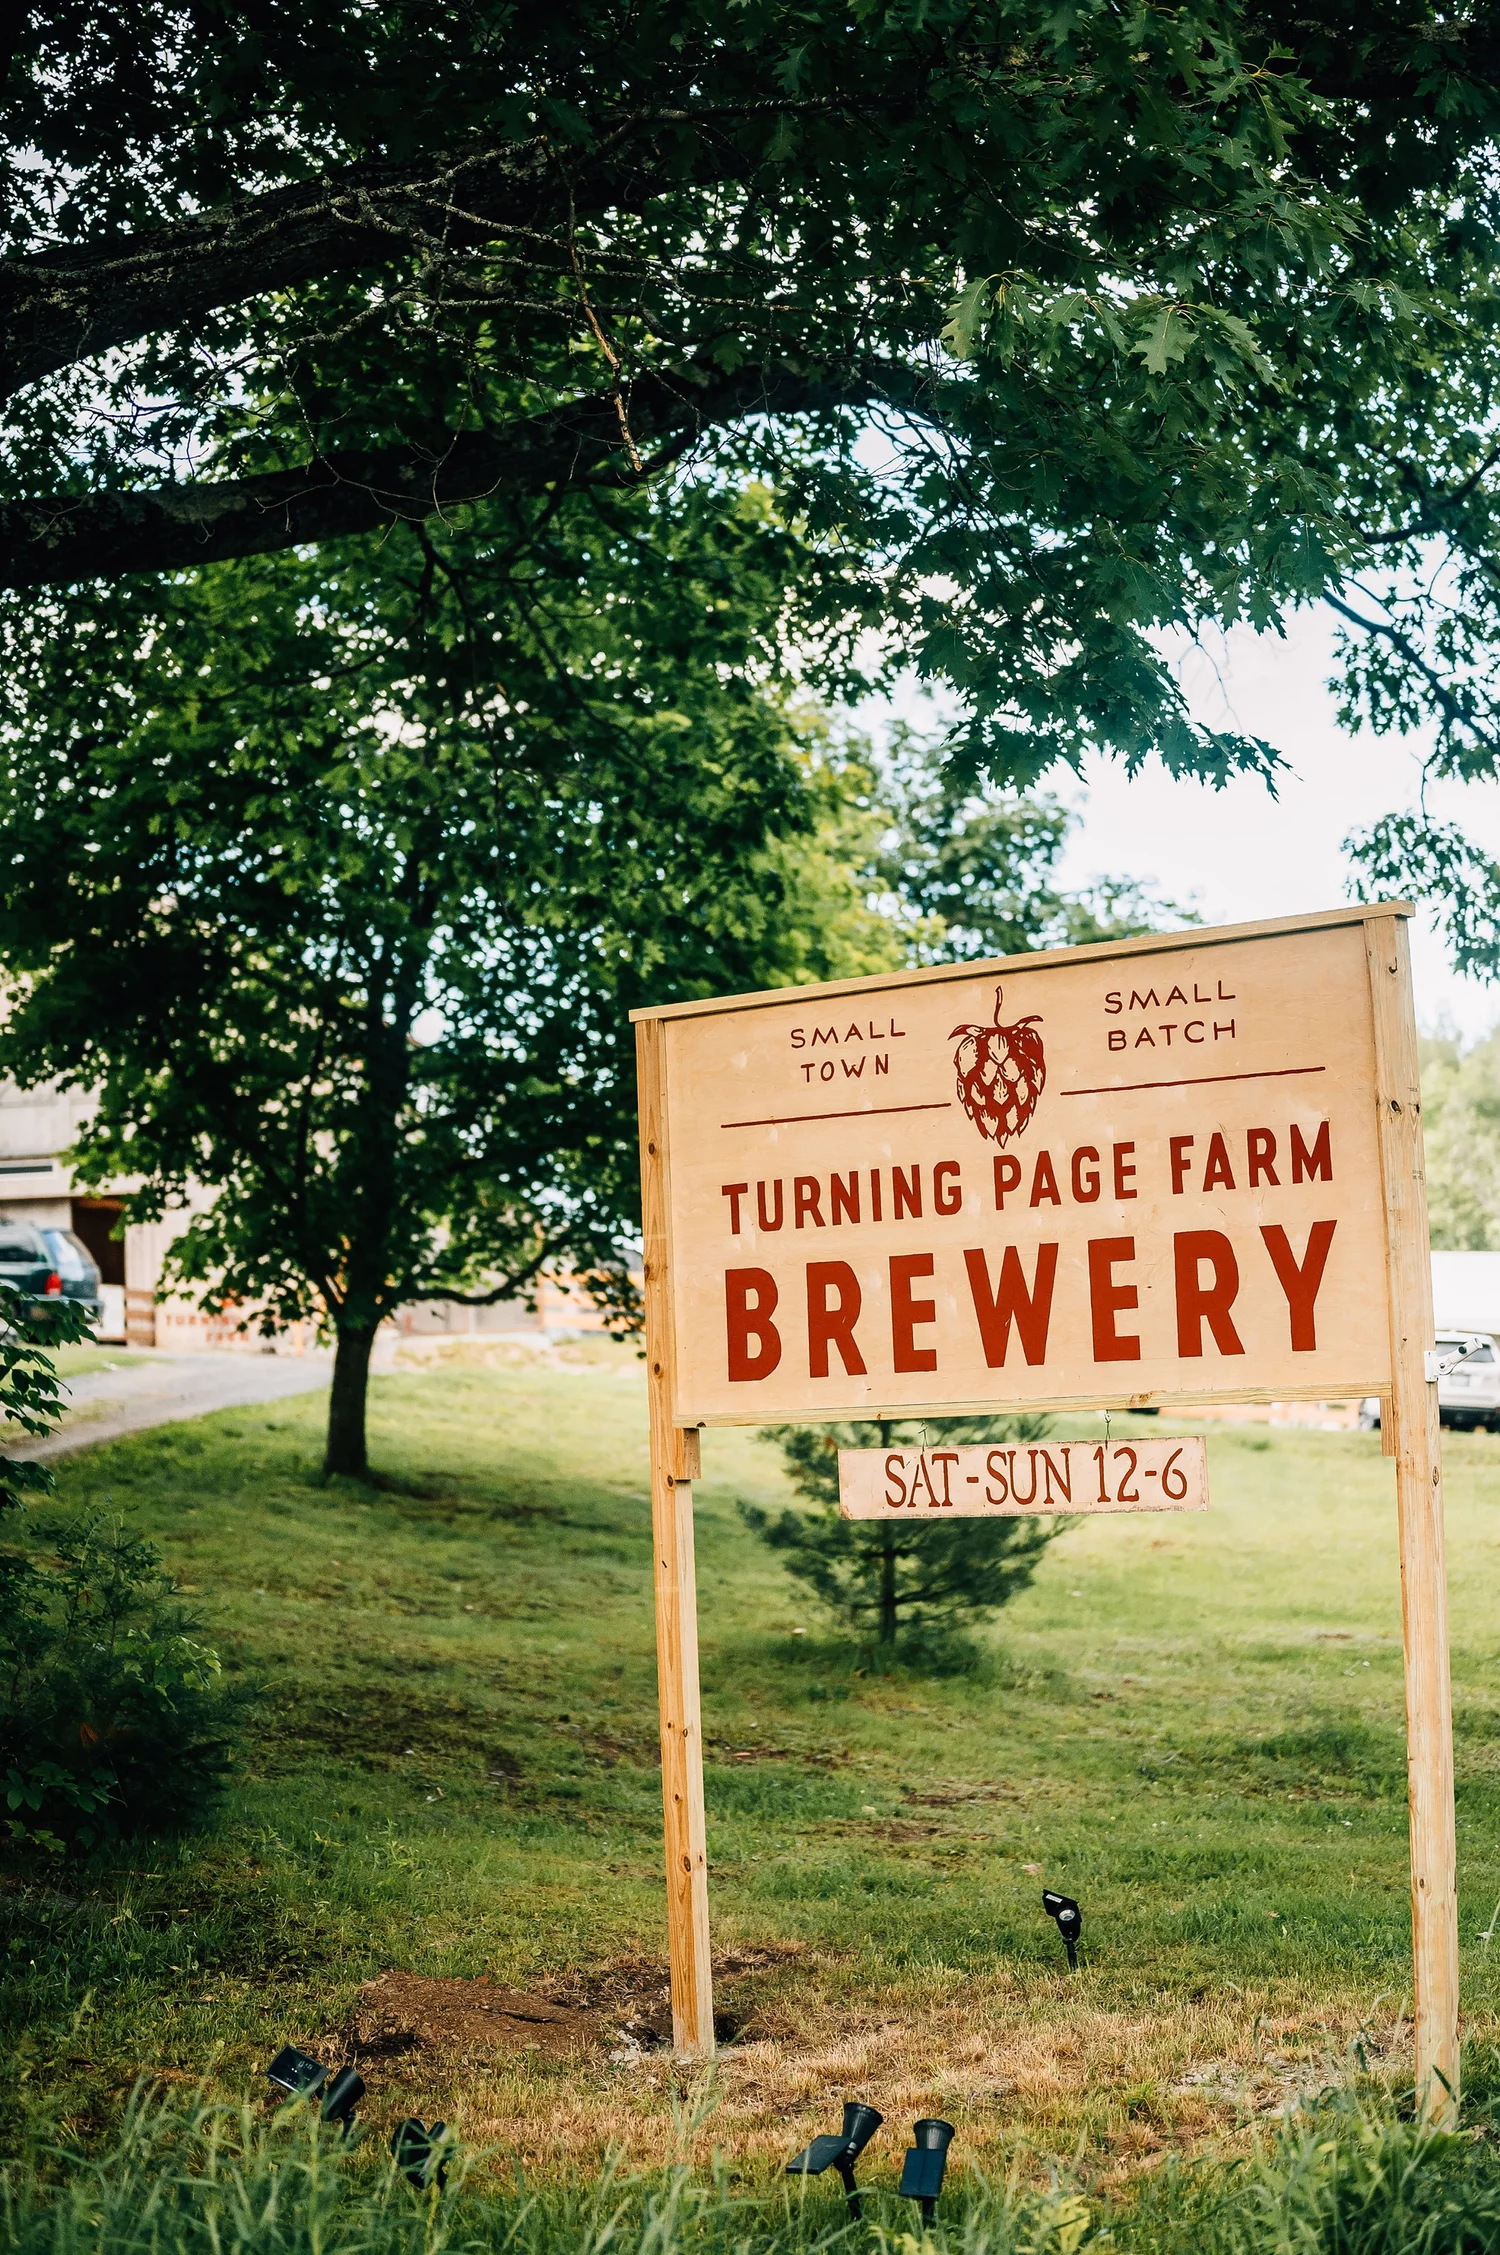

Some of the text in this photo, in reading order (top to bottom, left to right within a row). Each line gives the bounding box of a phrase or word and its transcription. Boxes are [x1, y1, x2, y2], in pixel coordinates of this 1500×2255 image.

[1105, 980, 1236, 1014] SMALL
[791, 1019, 906, 1048] SMALL
[1108, 1019, 1236, 1051] BATCH
[801, 1054, 889, 1082] TOWN
[722, 1118, 1333, 1234] TURNING PAGE FARM
[725, 1220, 1337, 1382] BREWERY
[885, 1446, 1188, 1508] SAT-SUN 12-6
